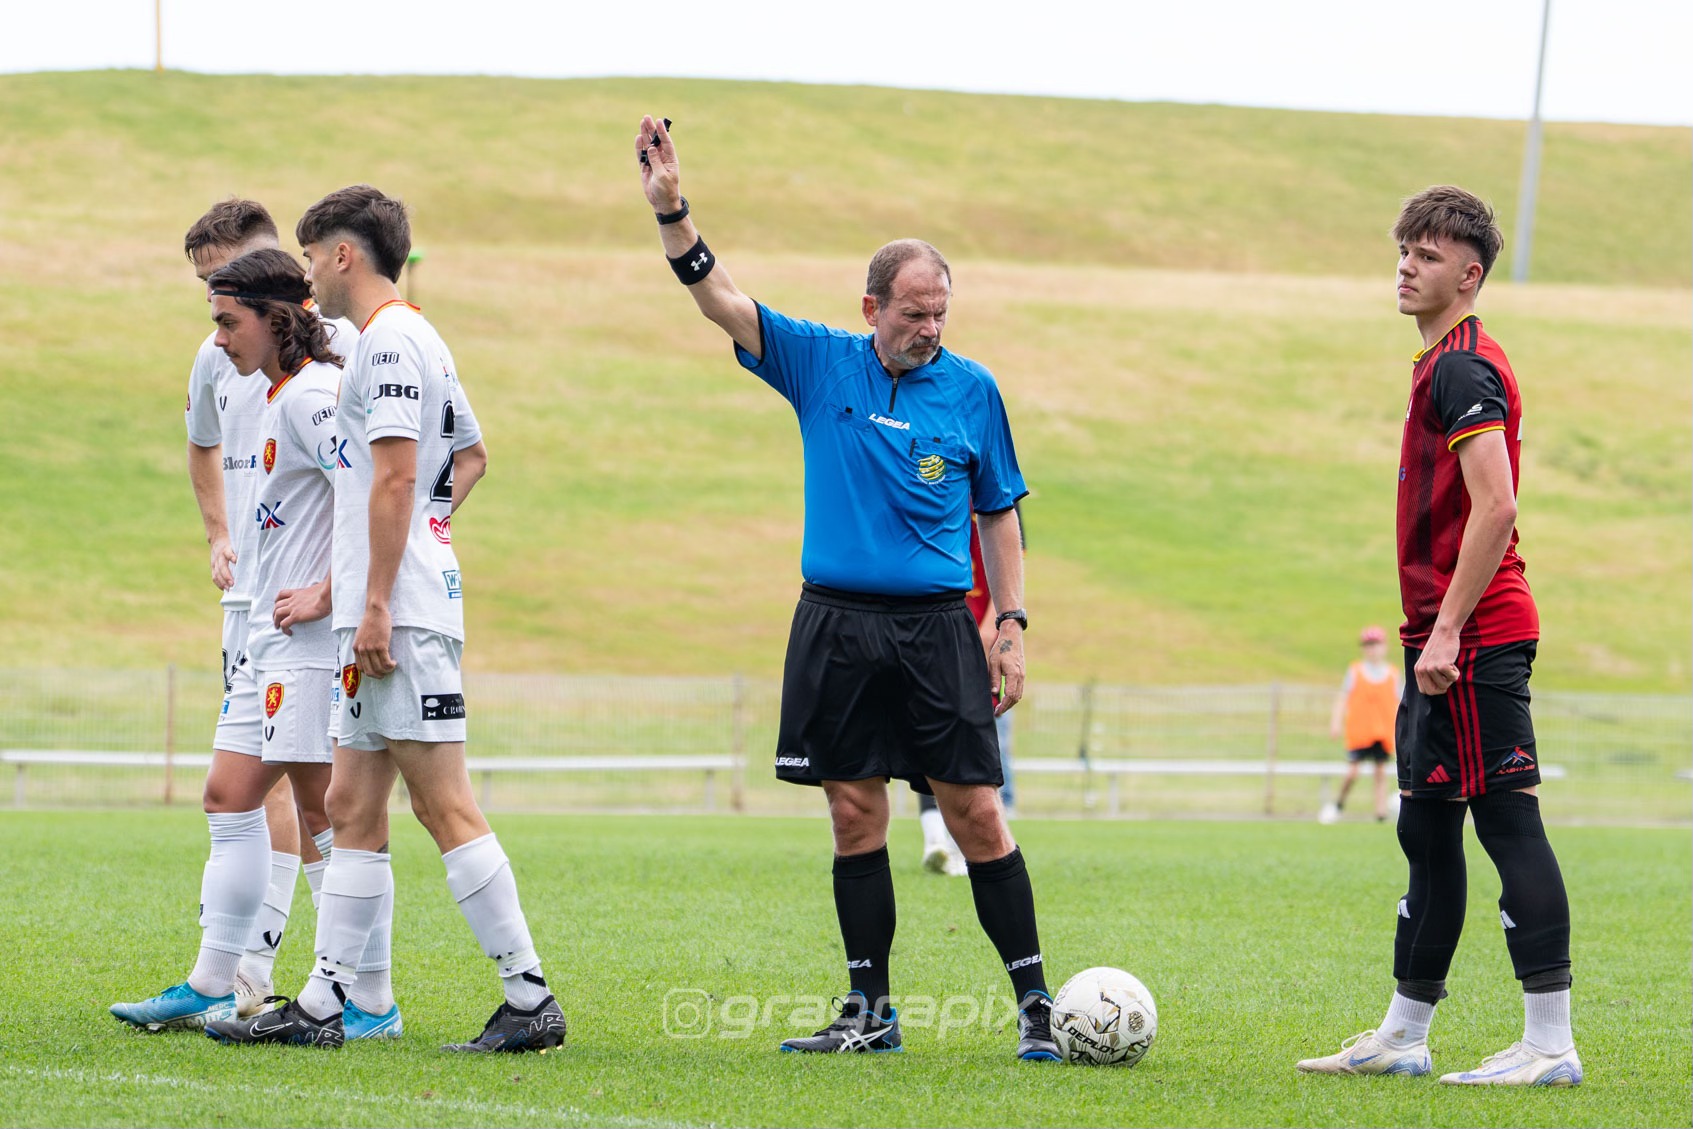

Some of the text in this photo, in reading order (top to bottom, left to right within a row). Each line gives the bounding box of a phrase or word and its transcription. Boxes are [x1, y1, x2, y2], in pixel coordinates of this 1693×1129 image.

[372, 352, 399, 366] VETO
[373, 384, 419, 400] JBG
[868, 413, 910, 430] LEGEA
[775, 757, 810, 767] LEGEA
[1067, 1025, 1119, 1055] DEPLOY
